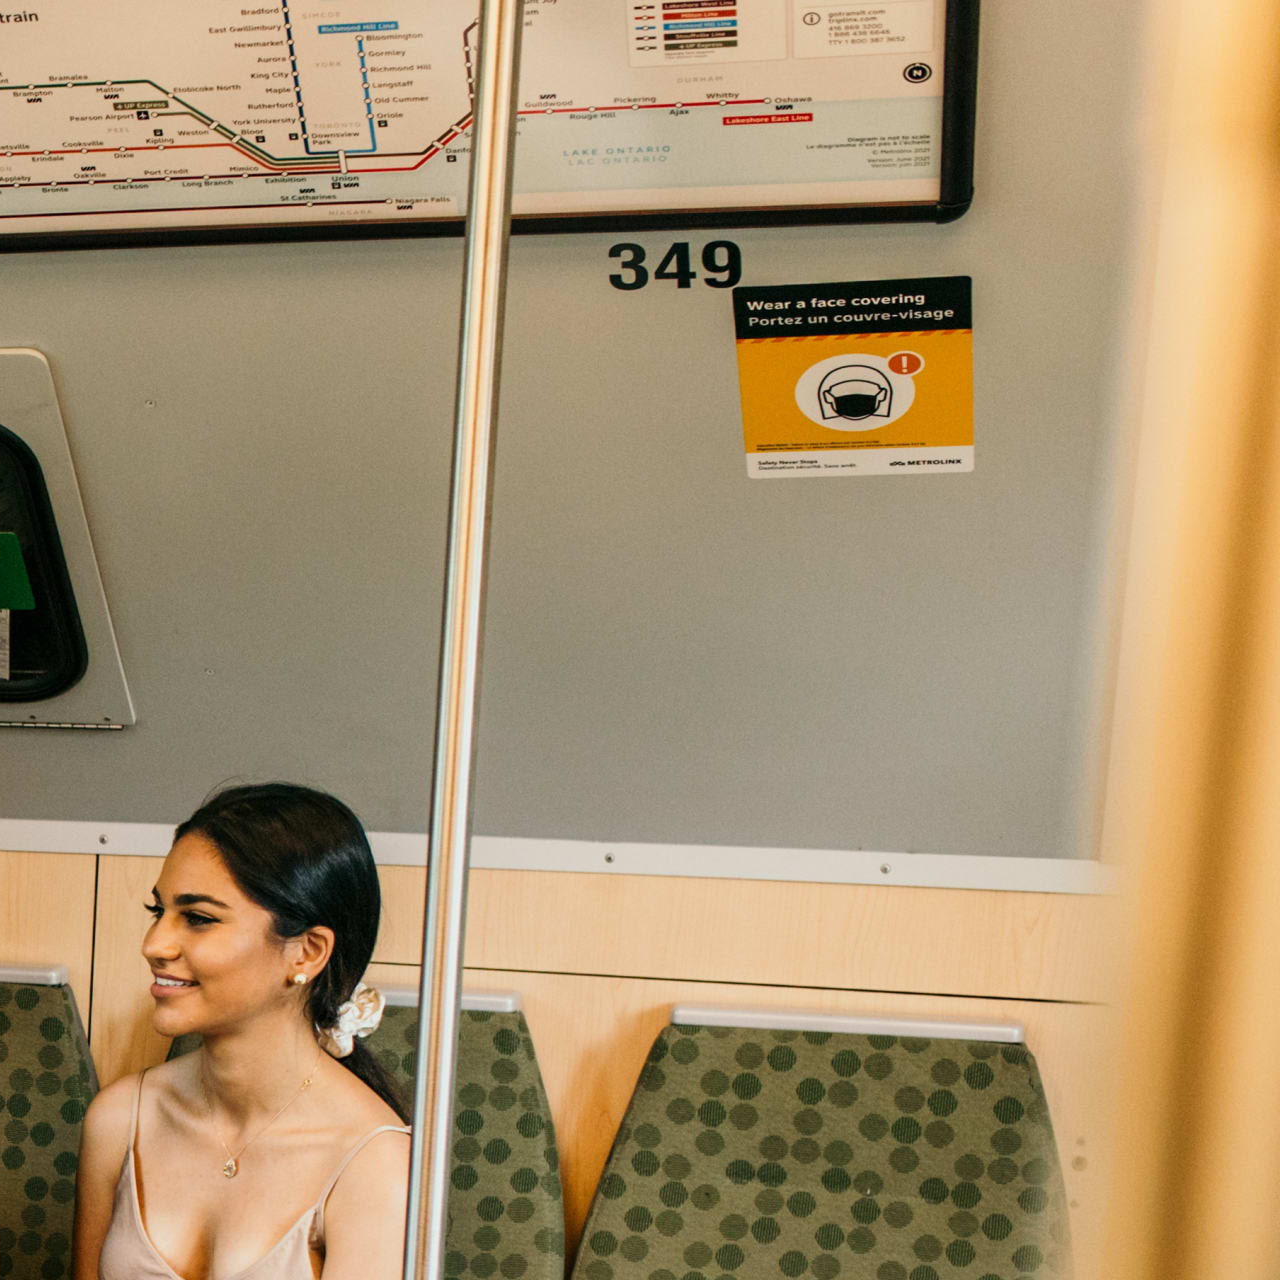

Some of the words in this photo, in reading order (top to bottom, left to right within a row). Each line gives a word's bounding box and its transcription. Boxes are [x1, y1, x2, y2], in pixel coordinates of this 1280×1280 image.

[241, 7, 279, 15] Bradford
[0, 11, 39, 23] train
[366, 32, 423, 42] Bloomington
[234, 40, 283, 48] Newmarket
[368, 49, 406, 58] Gormley
[370, 65, 413, 73] Richmond
[250, 72, 269, 80] King
[272, 71, 289, 80] City
[372, 80, 413, 89] Langstaff
[13, 90, 53, 98] Brampton
[173, 86, 215, 94] Etobicoke
[265, 86, 290, 94] Maple
[392, 95, 429, 103] Cummer
[614, 95, 656, 104] Pickering
[706, 91, 740, 100] Whitby
[137, 101, 166, 109] Express
[247, 101, 294, 109] Rutherford
[376, 112, 403, 120] Oriole
[256, 117, 296, 125] University
[726, 116, 769, 125] Lakeshore
[311, 131, 360, 139] Downsview
[62, 140, 104, 148] Cooksville
[146, 137, 174, 145] Kipling
[563, 148, 598, 157] LAKE
[606, 145, 671, 155] ONTARIO
[568, 158, 596, 166] LAC
[602, 155, 667, 165] ONTARIO
[265, 176, 307, 184] Exhibition
[292, 193, 337, 201] Catharines
[395, 198, 429, 206] Niagara
[607, 239, 742, 290] 349
[747, 300, 791, 311] Wear
[796, 301, 806, 309] a
[811, 296, 846, 307] face
[851, 293, 925, 306] covering
[748, 315, 803, 326] Portez
[808, 314, 828, 324] un
[834, 308, 954, 322] couvre-visage
[907, 458, 962, 466] METROLINX
